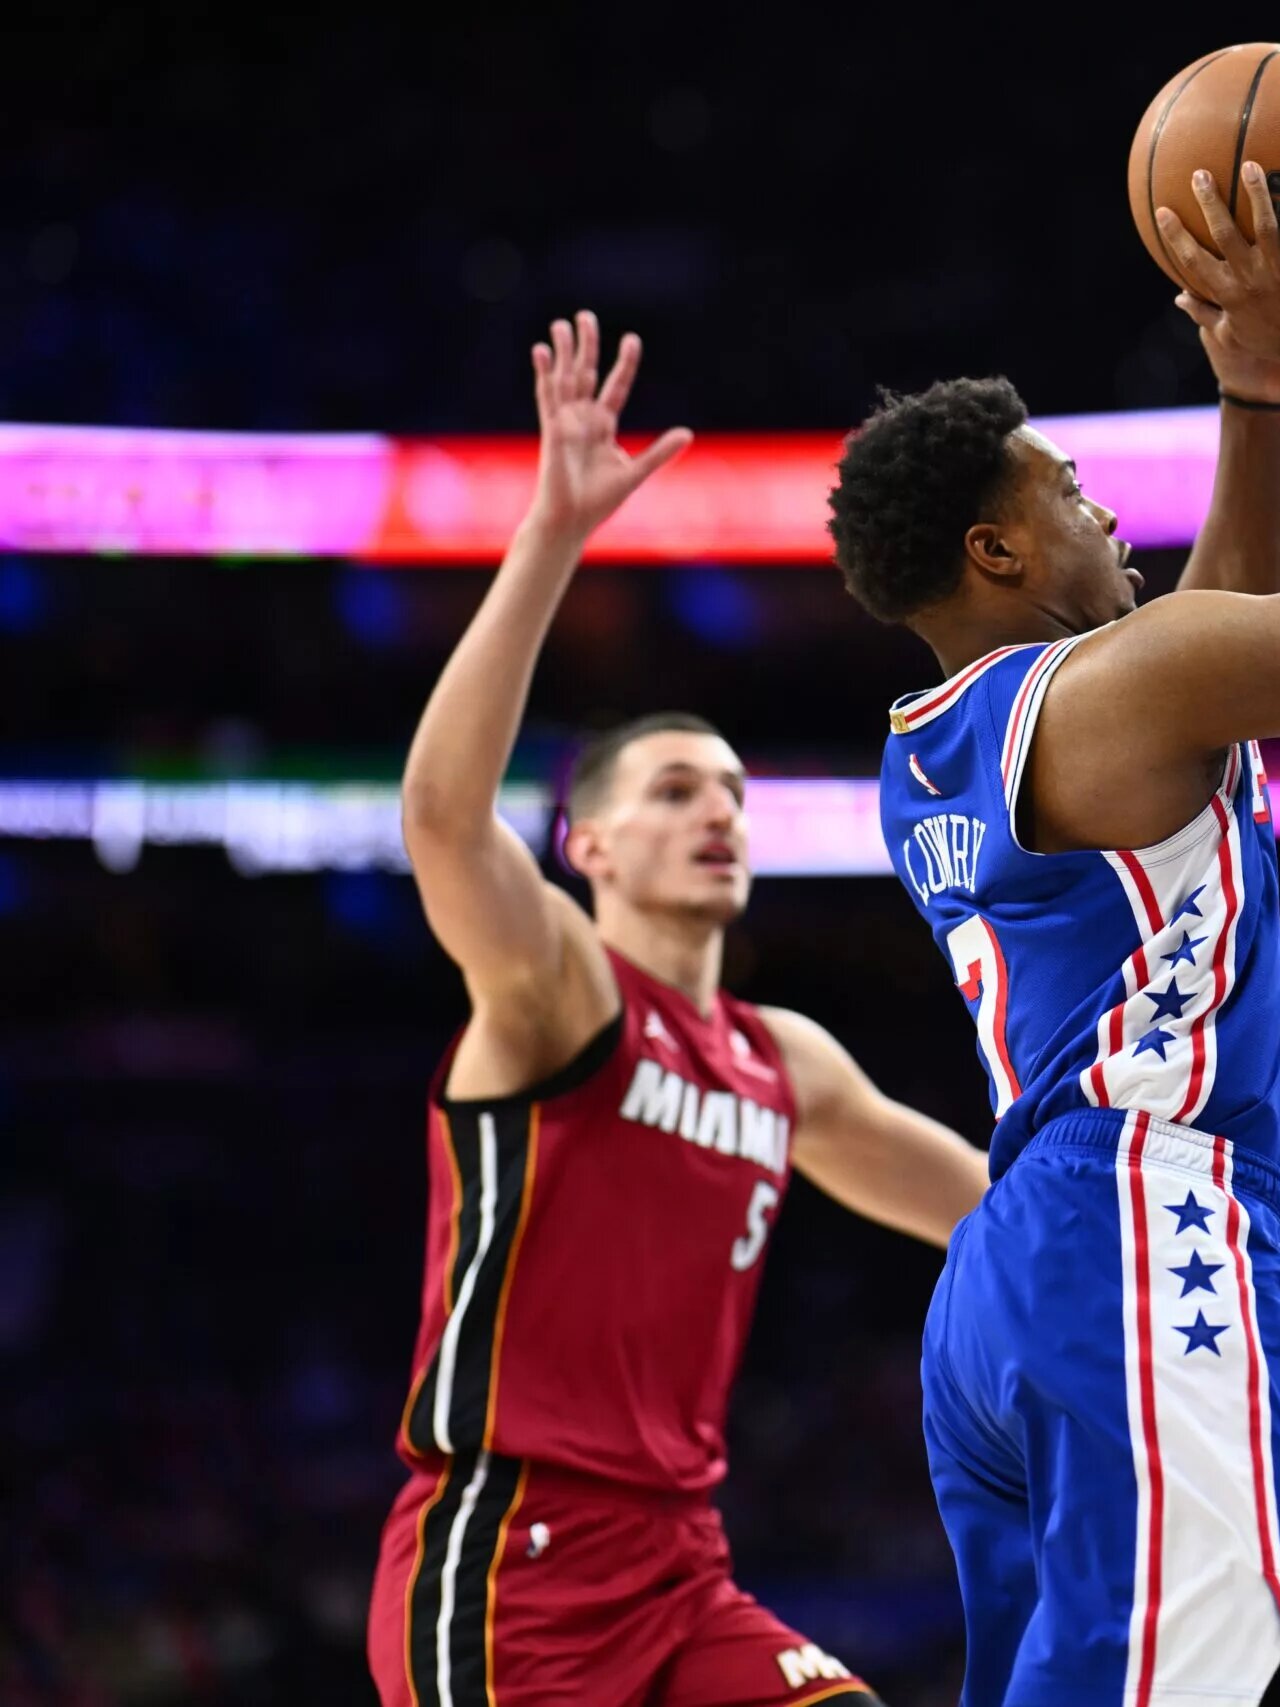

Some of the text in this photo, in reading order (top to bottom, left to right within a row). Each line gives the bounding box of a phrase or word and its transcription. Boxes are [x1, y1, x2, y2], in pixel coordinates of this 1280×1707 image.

[903, 813, 987, 907] LOWRY
[946, 913, 1023, 1124] 7
[619, 1058, 790, 1175] MIAMI
[730, 1179, 779, 1271] 5
